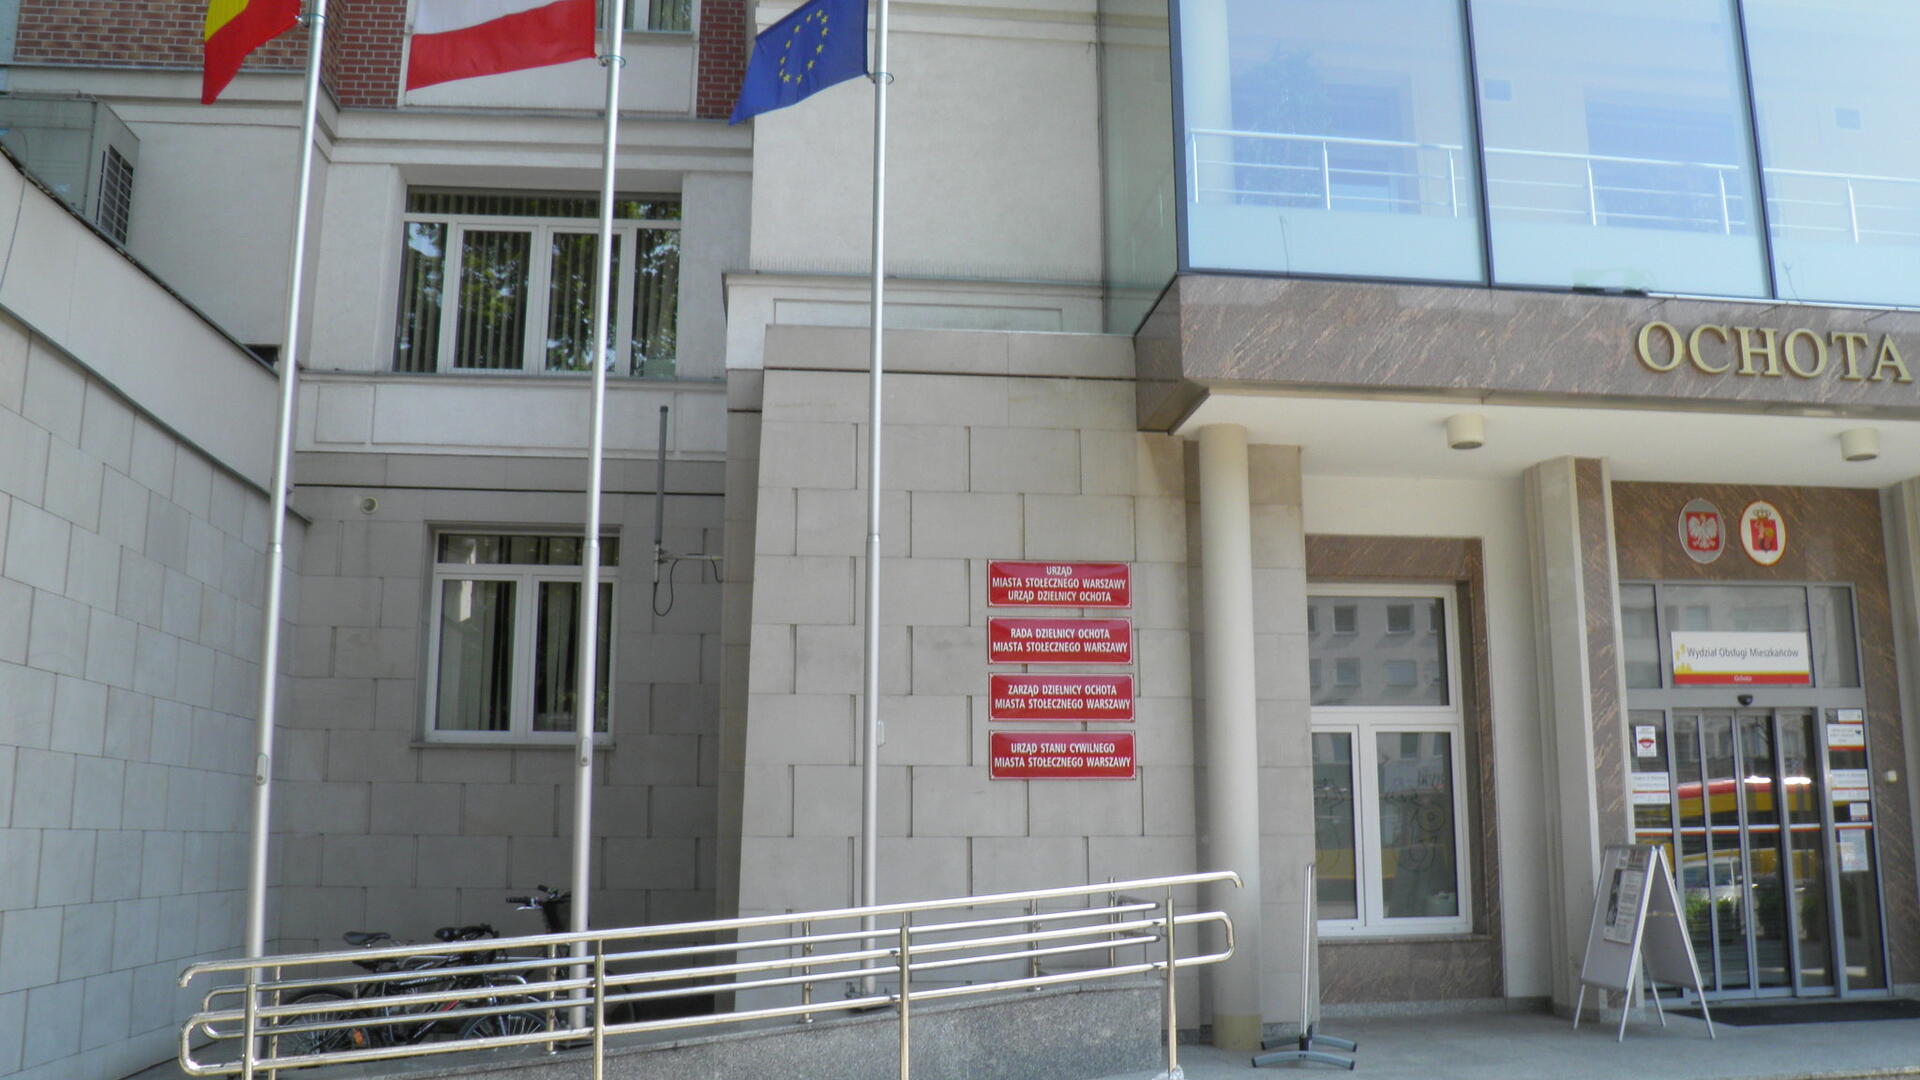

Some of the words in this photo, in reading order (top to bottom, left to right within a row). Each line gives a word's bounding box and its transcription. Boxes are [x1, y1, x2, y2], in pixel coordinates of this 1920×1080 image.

[1636, 320, 1914, 383] OCHOTA
[1046, 566, 1073, 577] URZĄD
[993, 578, 1022, 587] MIASTA
[1025, 578, 1079, 588] STOŁECZNEGO
[1082, 579, 1125, 589] WARSZAWY
[1008, 591, 1034, 603] URZĄD
[1038, 591, 1076, 601] DZIELNICY
[1080, 592, 1111, 601] OCHOTA
[1011, 628, 1032, 638] RADA
[1036, 628, 1075, 638] DZIELNICY
[1078, 628, 1110, 639] OCHOTA
[993, 642, 1023, 652] MIASTA
[1026, 642, 1080, 652] STOŁECZNEGO
[1084, 642, 1127, 652] WARSZAWY
[1687, 647, 1717, 660] Wydział
[1719, 647, 1748, 660] Obsługi
[1749, 647, 1799, 657] Mieszkańców
[1008, 685, 1039, 697] ZARZĄD
[1042, 685, 1081, 695] DZIELNICY
[1085, 685, 1117, 695] OCHOTA
[995, 699, 1025, 708] MIASTA
[1029, 699, 1083, 709] STOŁECZNEGO
[1087, 699, 1130, 709] WARSZAWY
[1011, 743, 1037, 755] URZĄD
[1041, 743, 1066, 753] STANU
[1070, 743, 1115, 753] CYWILNEGO
[995, 757, 1025, 767] MIASTA
[1028, 757, 1083, 767] STOŁECZNEGO
[1087, 757, 1131, 767] WARSZAWY
